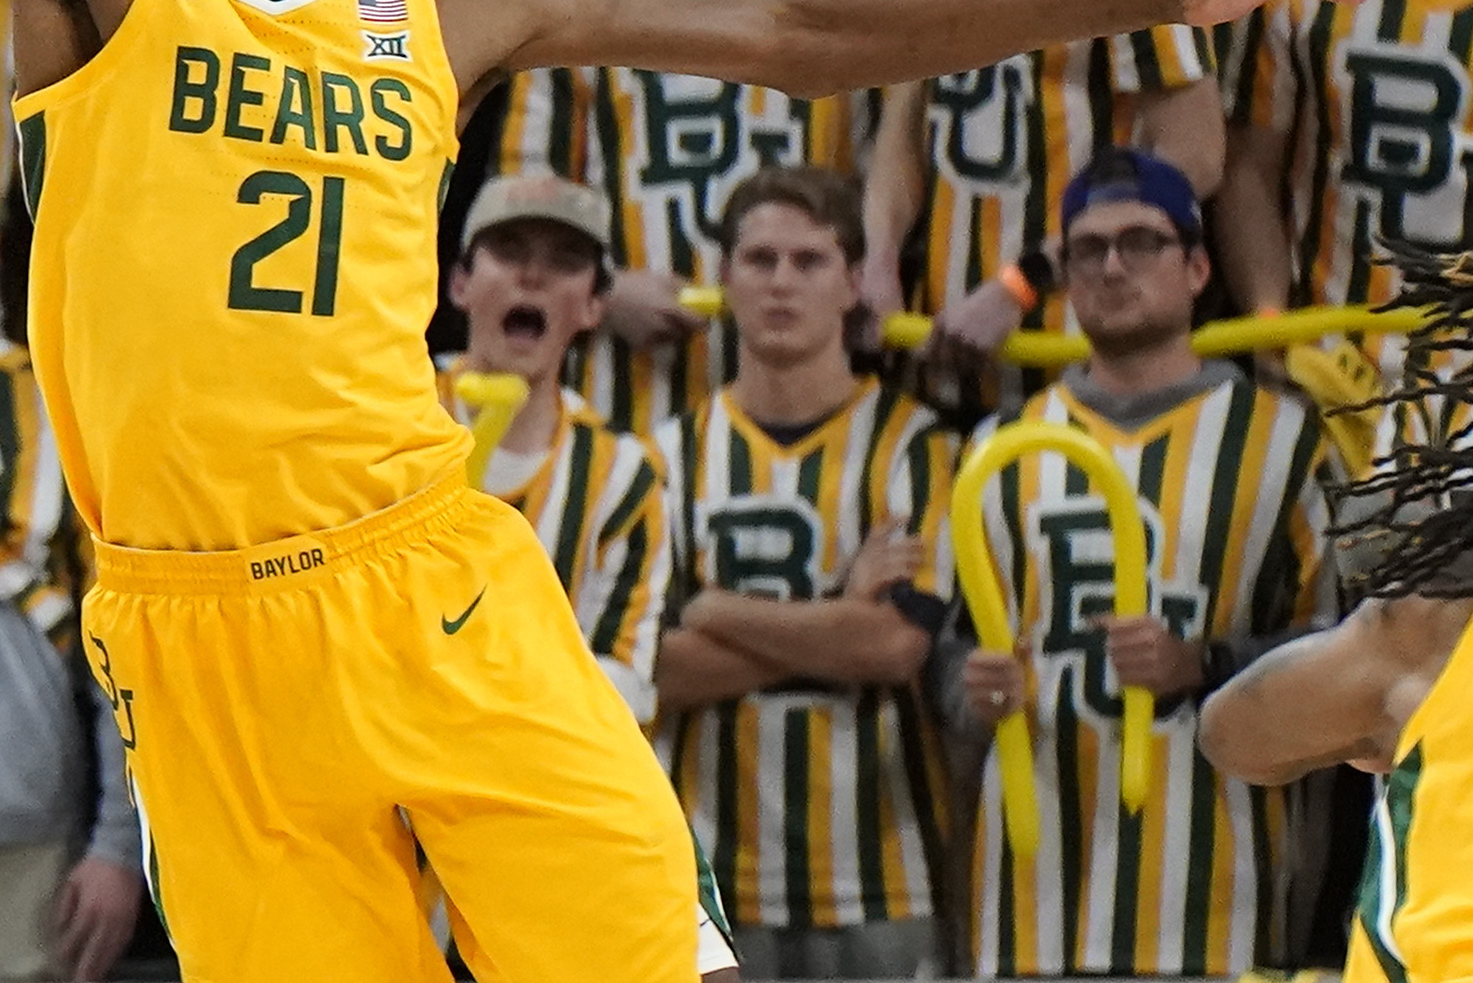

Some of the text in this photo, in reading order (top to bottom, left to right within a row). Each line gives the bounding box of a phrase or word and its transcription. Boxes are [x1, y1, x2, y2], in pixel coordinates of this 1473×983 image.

[366, 34, 408, 58] XII
[169, 45, 413, 162] BEARS
[228, 170, 345, 317] 21
[250, 548, 325, 580] BAYLOR
